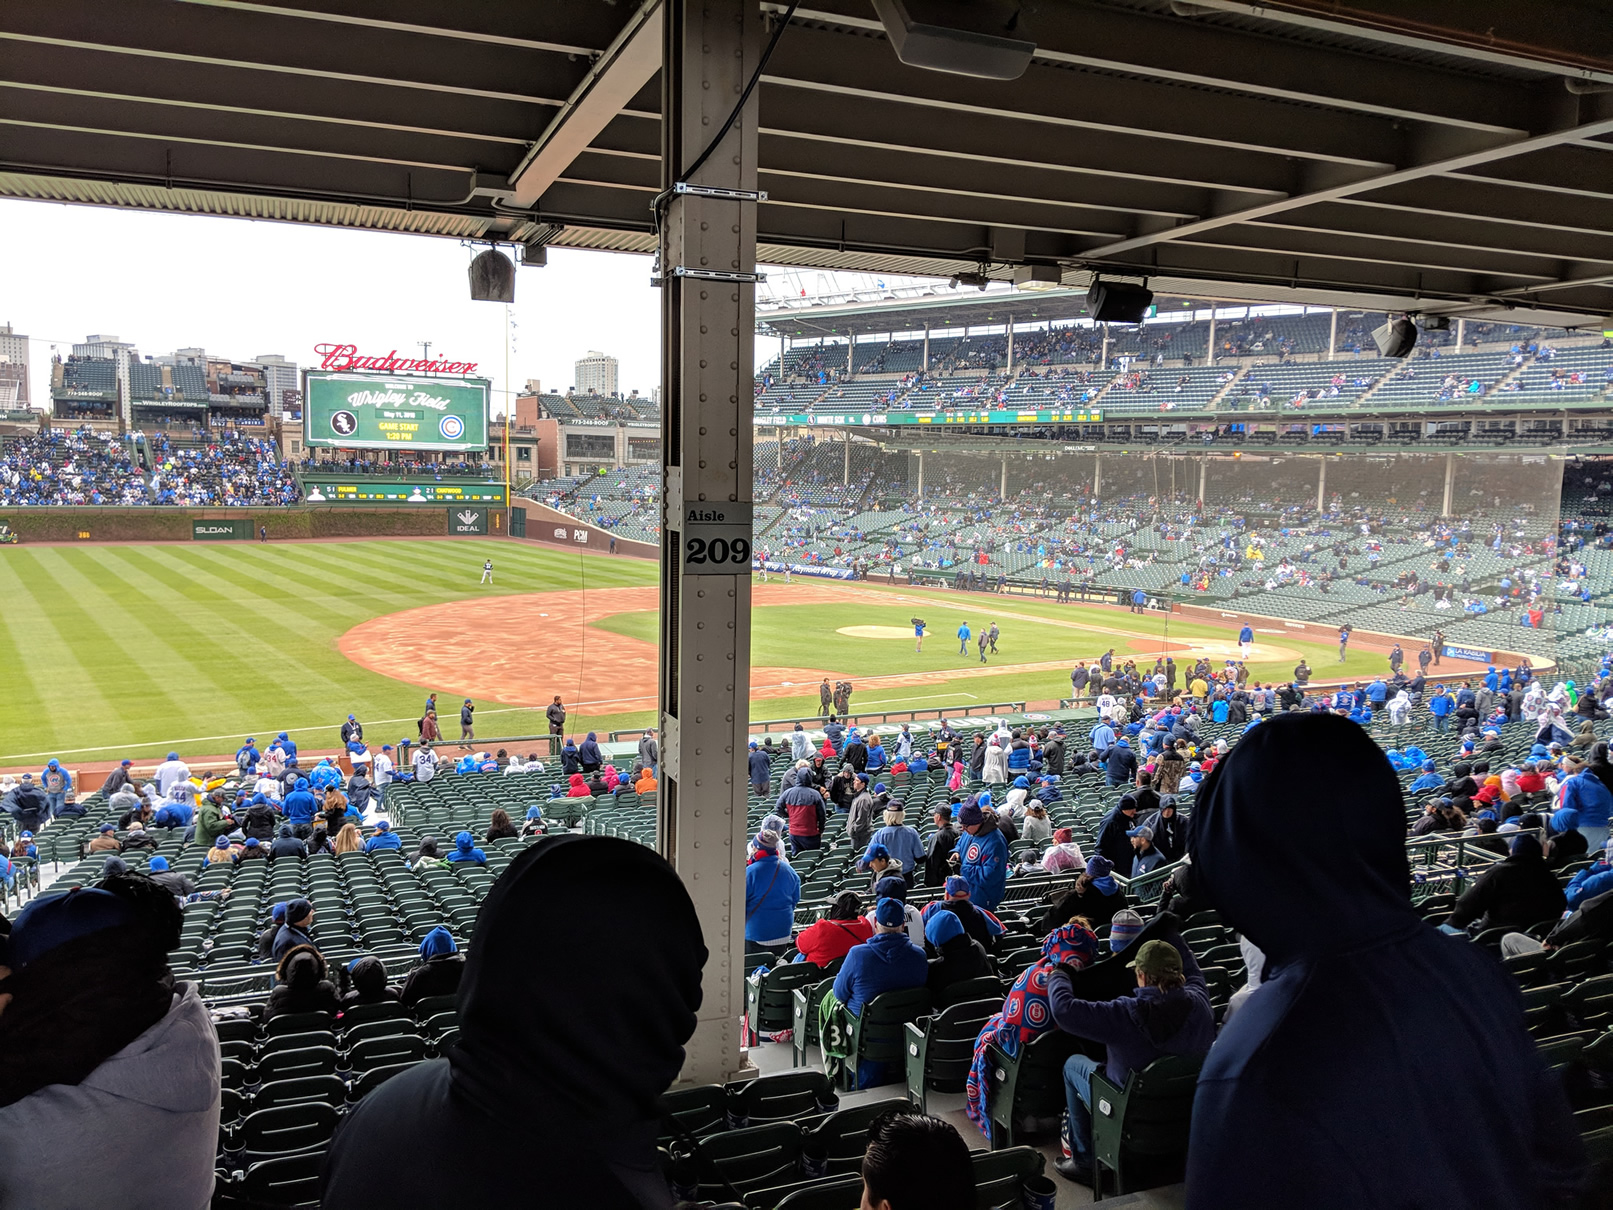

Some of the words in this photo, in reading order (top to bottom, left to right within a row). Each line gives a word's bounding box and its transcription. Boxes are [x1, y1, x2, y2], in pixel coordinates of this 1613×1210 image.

[314, 343, 479, 374] Budweiser
[347, 390, 407, 408] Wrigley
[409, 392, 450, 411] Field
[379, 422, 398, 431] GAME
[399, 423, 419, 431] START
[386, 432, 400, 440] 1:20
[688, 510, 724, 521] Aisle
[195, 526, 232, 534] SLOAN
[573, 529, 588, 541] PCM
[686, 538, 750, 564] 209
[791, 564, 820, 574] Reynolds
[820, 566, 839, 576] Wrap
[267, 754, 277, 763] 34
[419, 755, 431, 765] 34
[174, 791, 186, 802] 44
